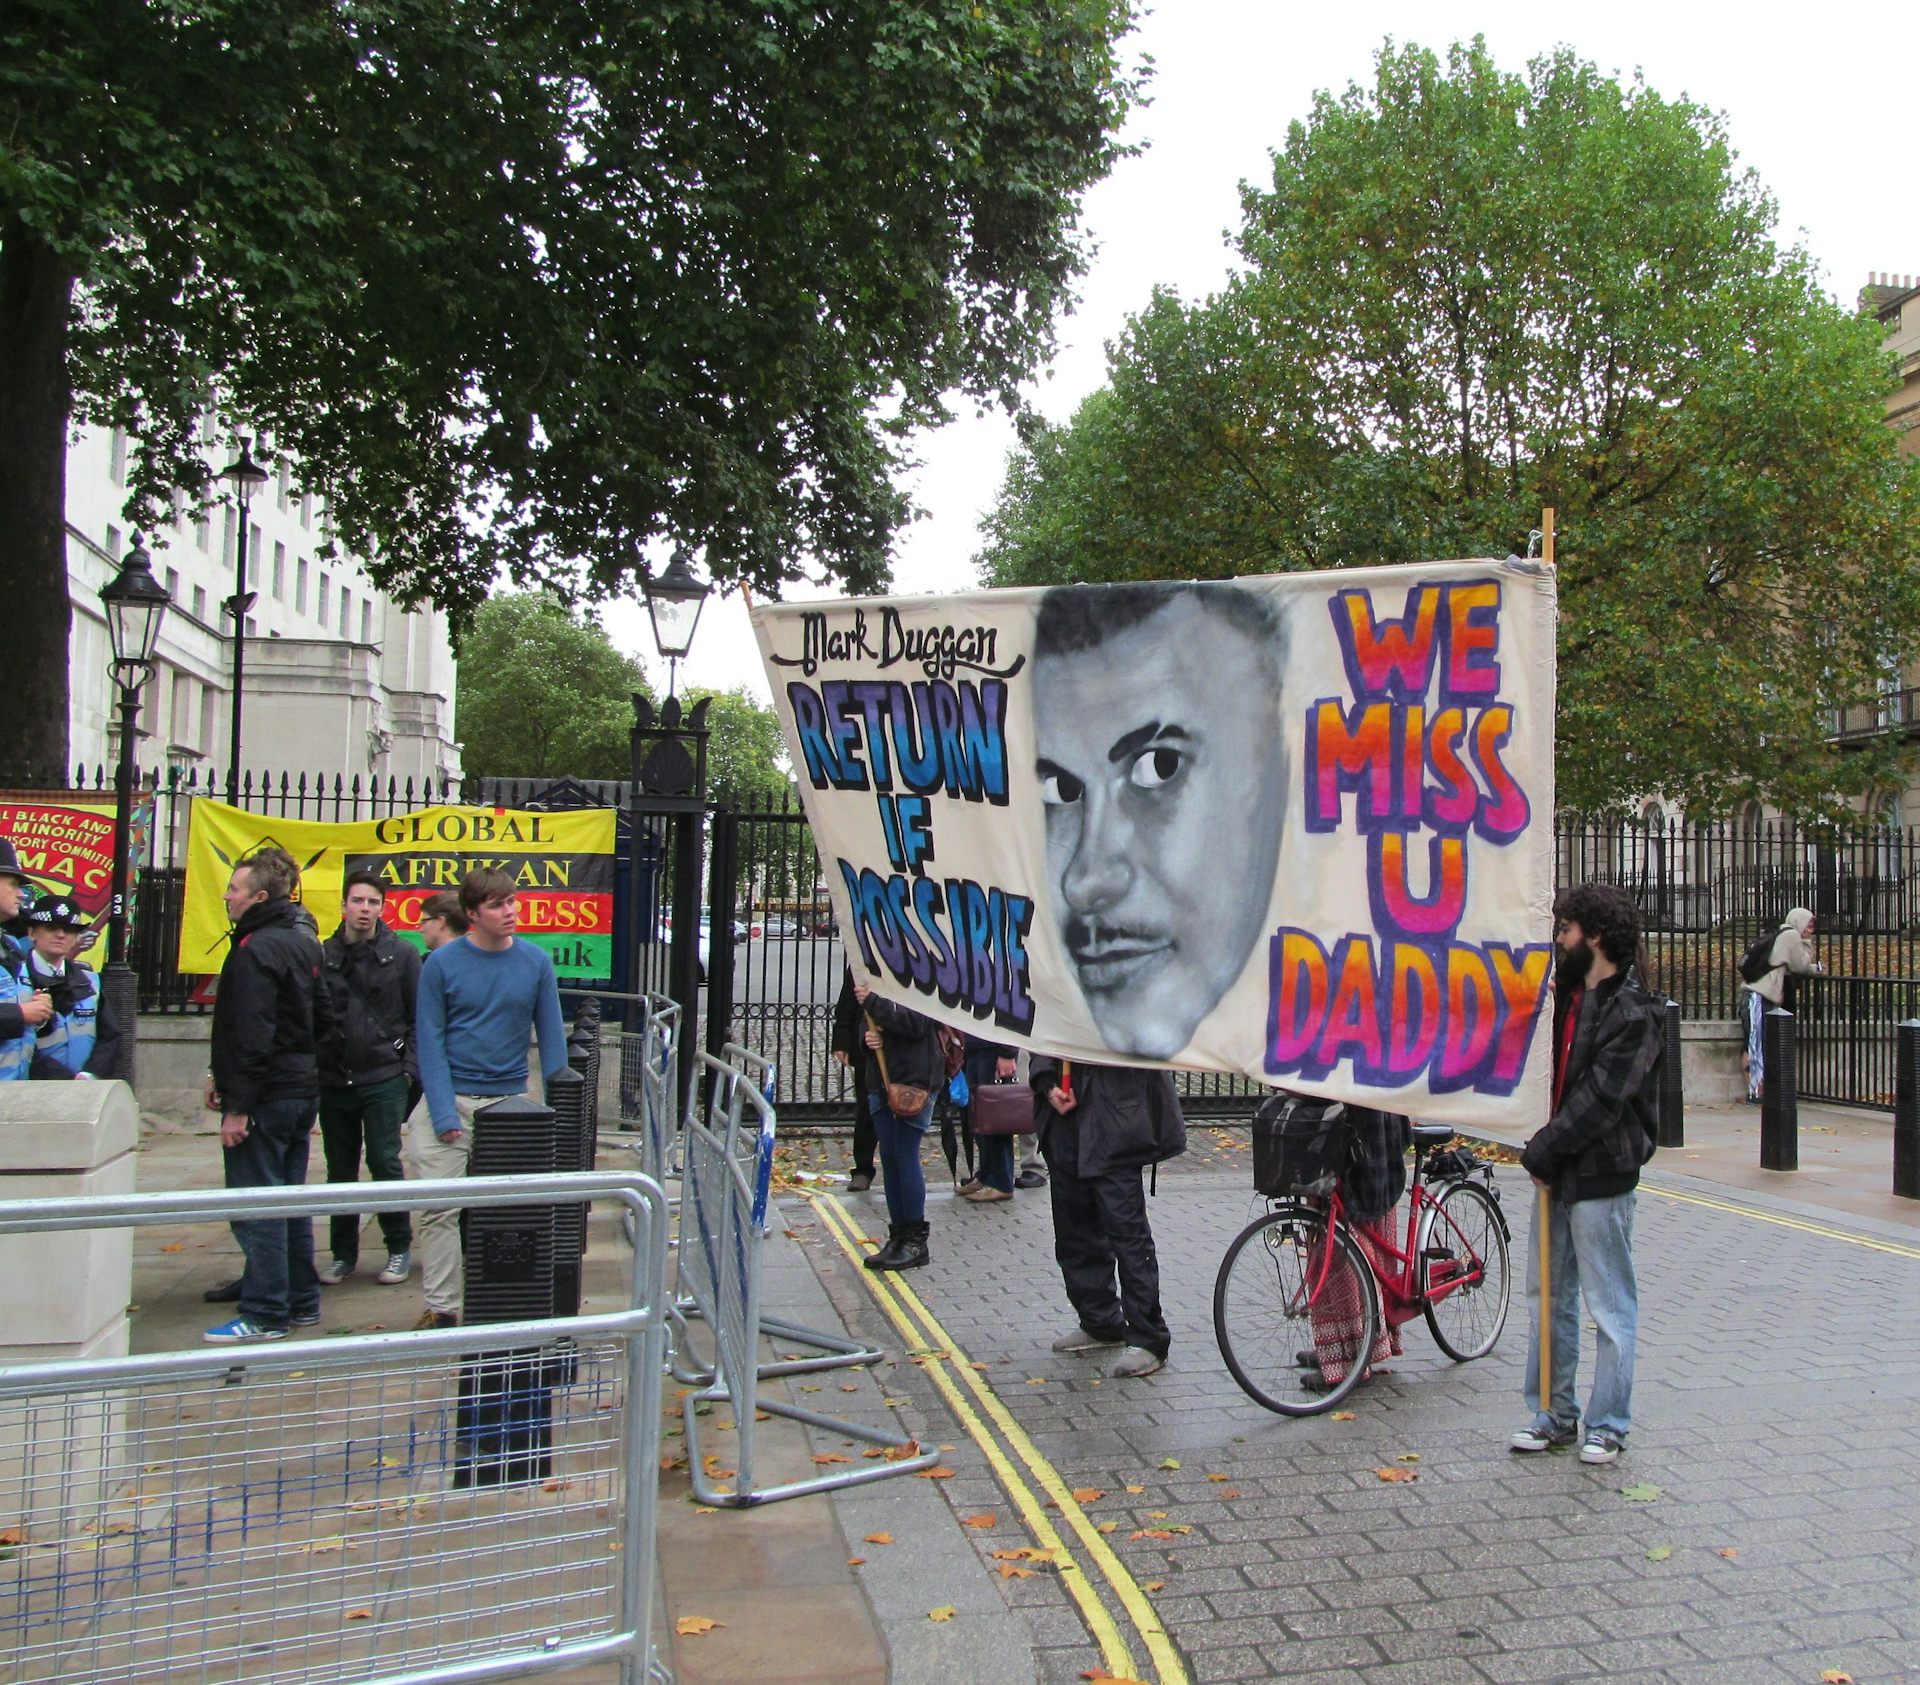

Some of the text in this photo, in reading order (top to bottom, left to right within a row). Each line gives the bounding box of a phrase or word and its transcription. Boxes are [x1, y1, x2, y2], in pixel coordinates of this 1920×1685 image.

[770, 606, 1025, 680] Mark Duggan
[1327, 578, 1501, 707] WE
[787, 679, 1009, 806] RETURN
[1304, 697, 1531, 846] MISS
[12, 821, 103, 847] MINORITY
[16, 811, 75, 826] BLACK
[78, 819, 112, 835] AND
[375, 815, 555, 844] GLOBAL
[876, 792, 934, 876] IF
[384, 897, 599, 929] OESS
[1366, 831, 1468, 940] U
[552, 941, 595, 968] uk
[837, 857, 1035, 1037] POSSIBLE
[1263, 926, 1553, 1097] DADDY
